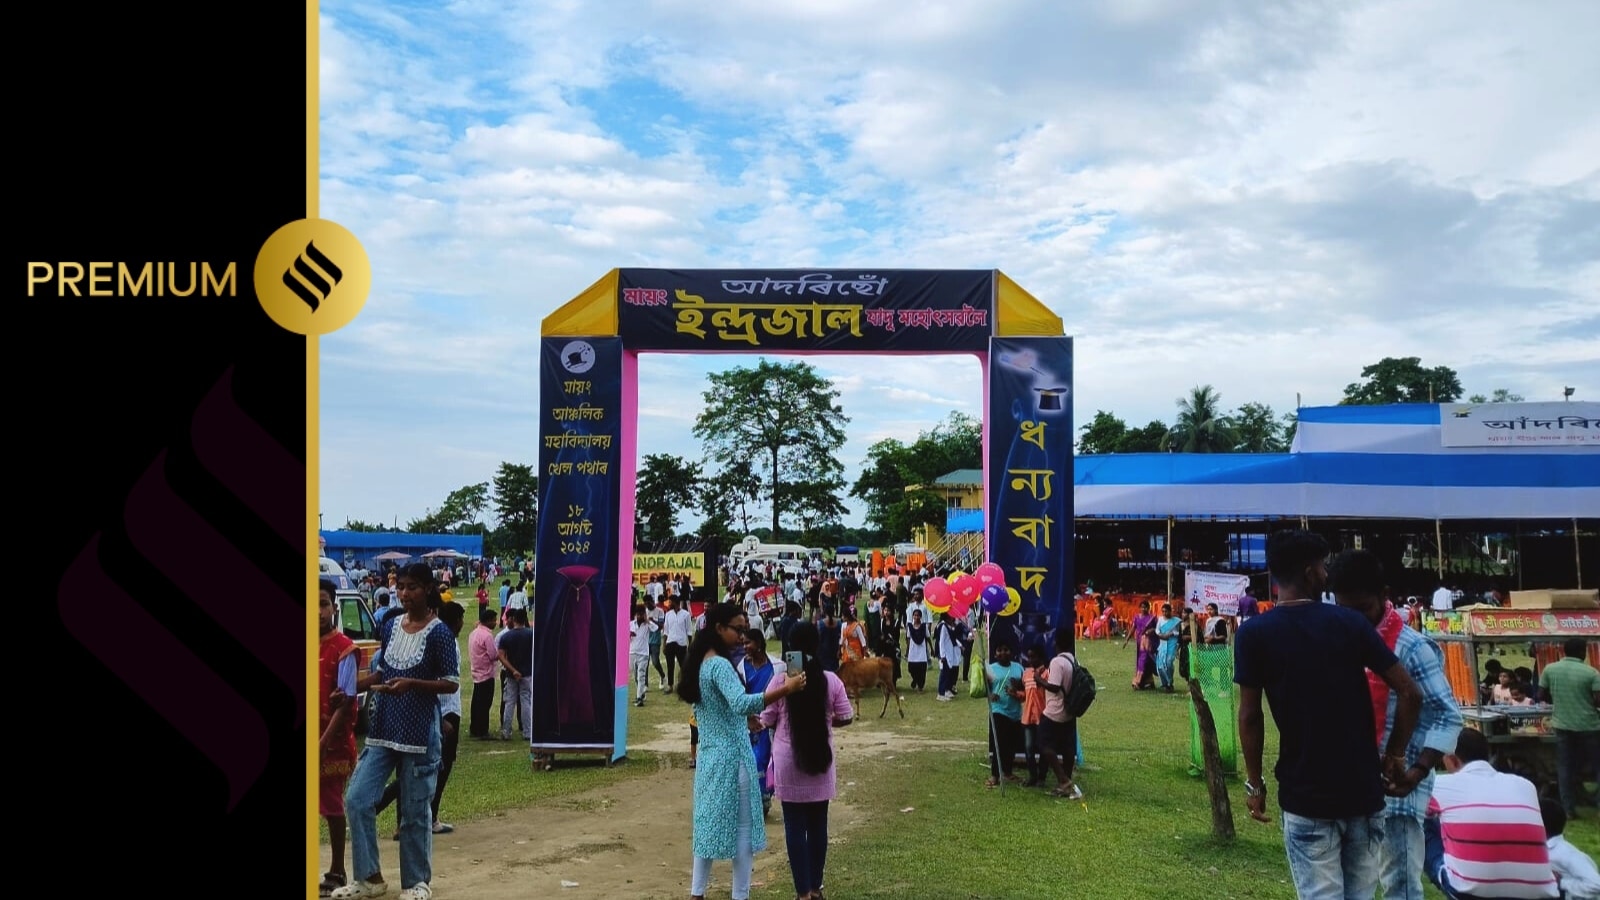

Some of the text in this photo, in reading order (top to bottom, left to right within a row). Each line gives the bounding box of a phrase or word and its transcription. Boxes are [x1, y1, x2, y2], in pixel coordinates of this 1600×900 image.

[623, 287, 668, 306] মায়ং
[564, 379, 592, 396] মায়ং
[552, 402, 604, 421] আঞ্চলিক
[545, 429, 612, 450] মহাবিদ্যালয়
[548, 462, 573, 476] খেল
[568, 504, 584, 518] ১৮
[560, 541, 591, 555] ২০২৪
[633, 556, 701, 570] INDRAJAL
